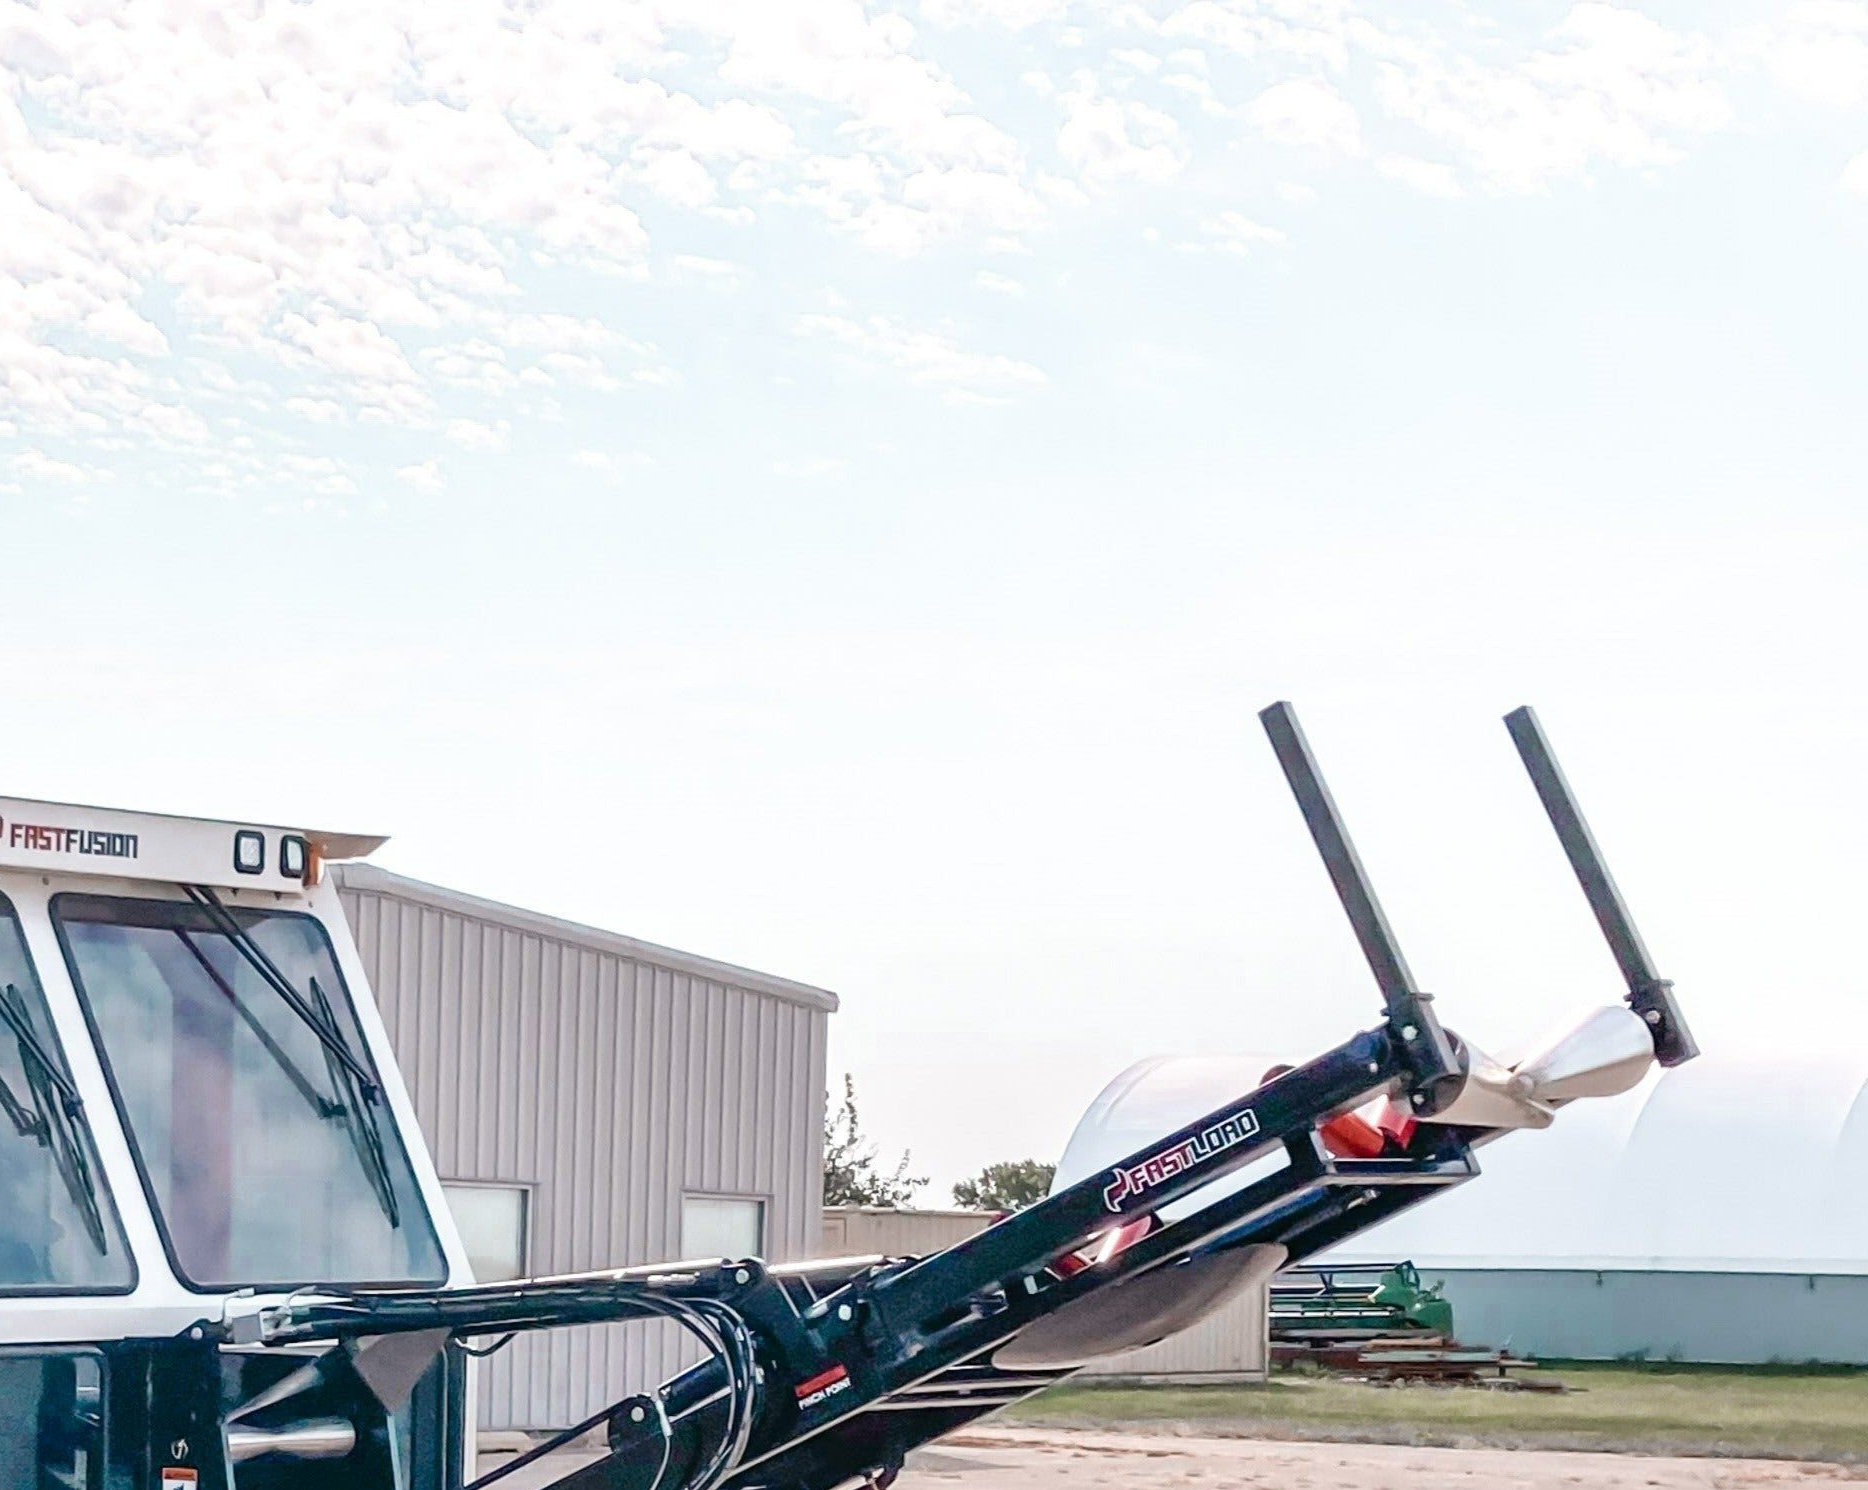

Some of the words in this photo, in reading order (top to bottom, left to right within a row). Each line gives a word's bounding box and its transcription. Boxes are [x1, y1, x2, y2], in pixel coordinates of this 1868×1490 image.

[10, 823, 138, 859] FASTFUSION
[1128, 1110, 1259, 1194] FASTLOAD
[824, 1376, 851, 1397] POINT
